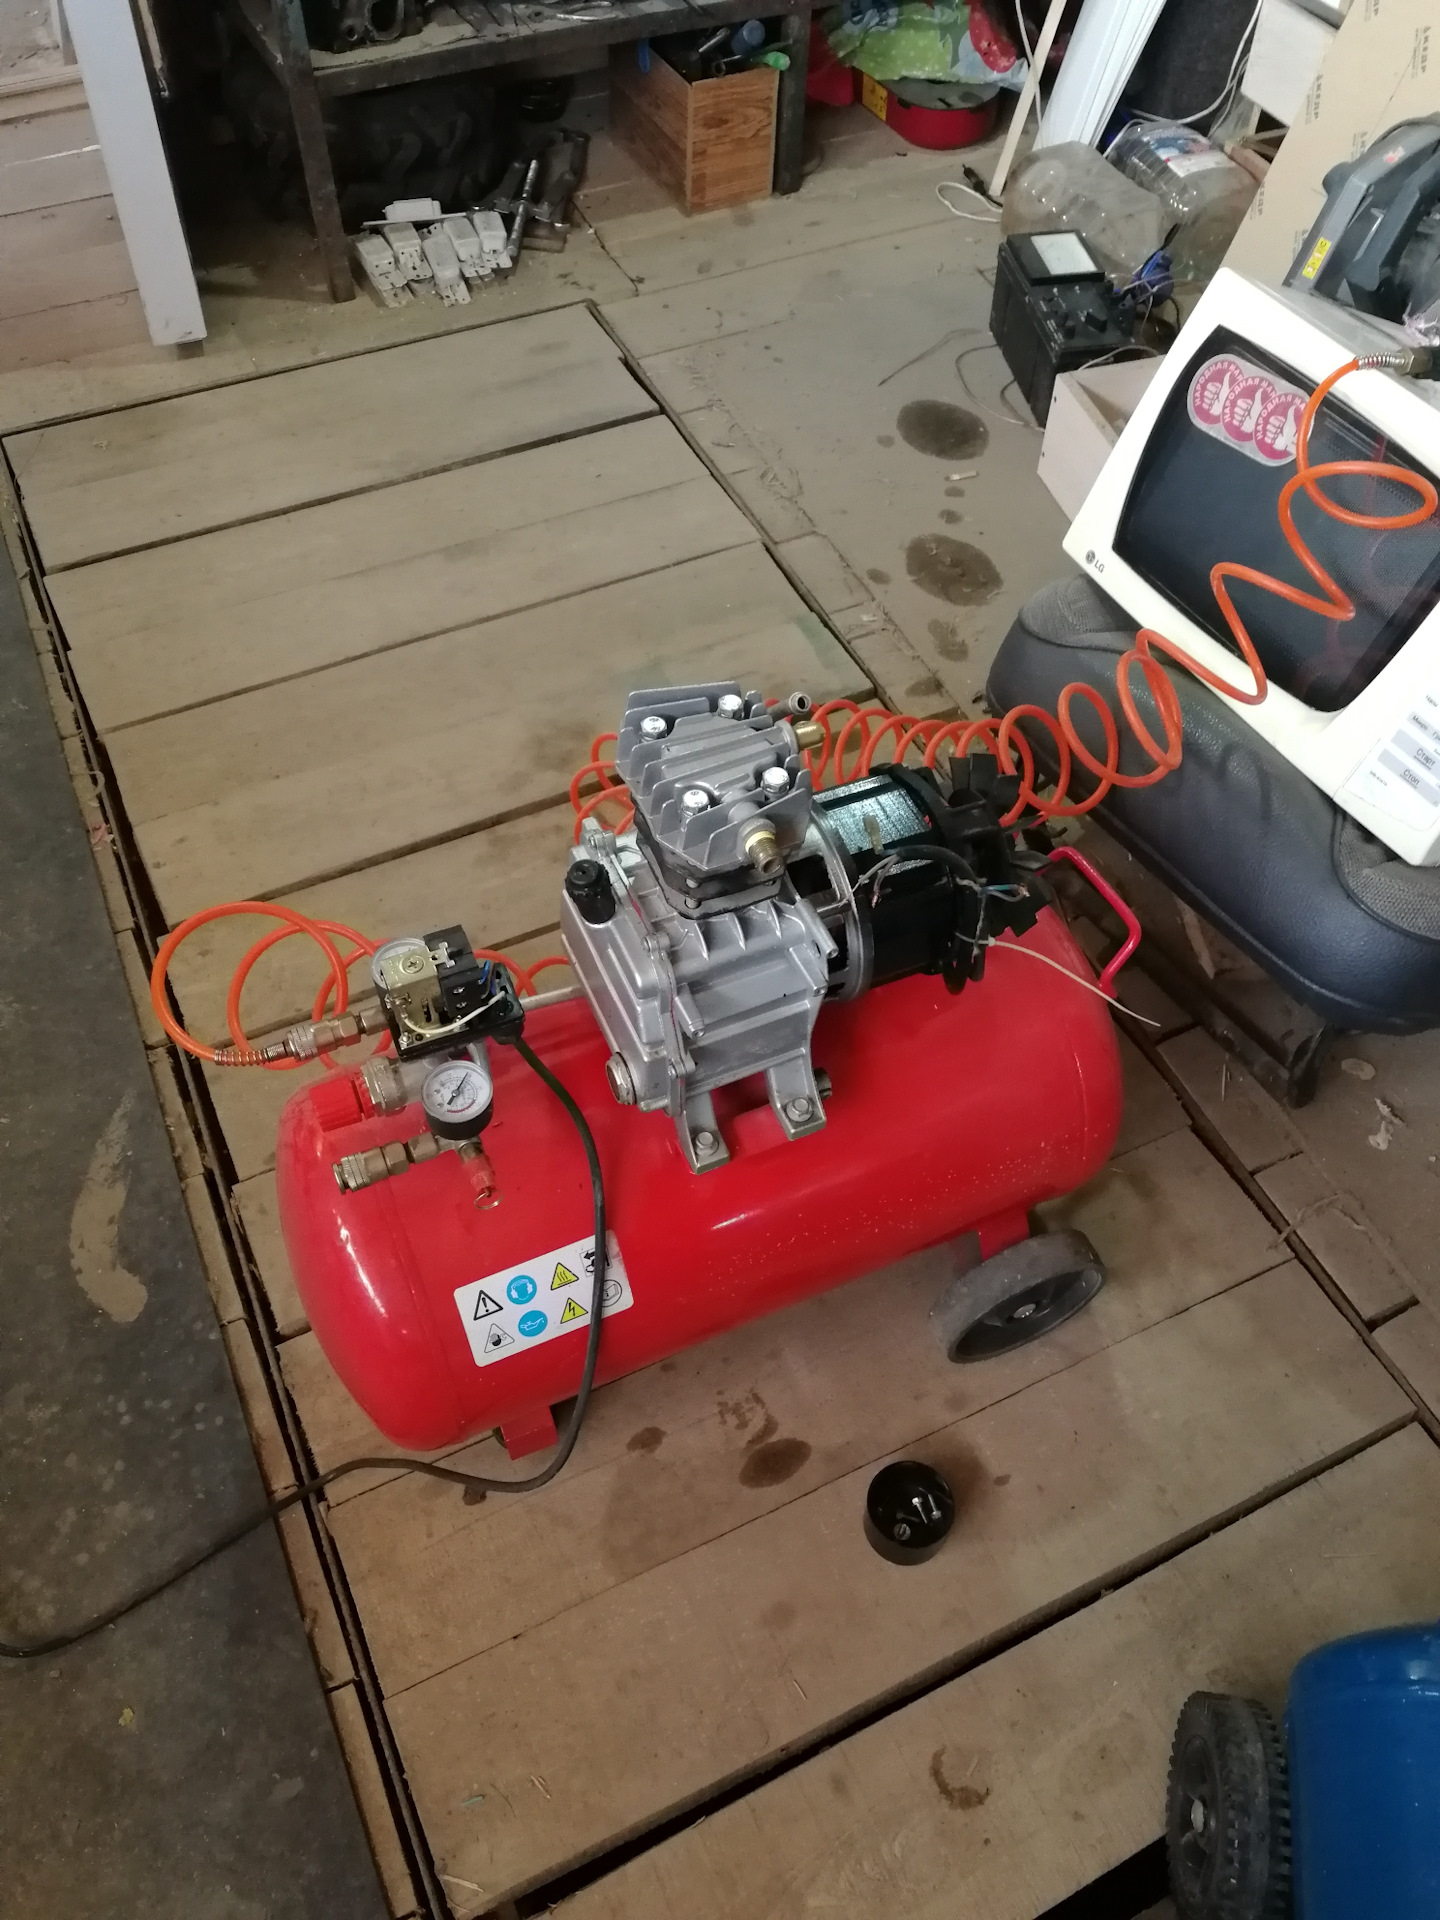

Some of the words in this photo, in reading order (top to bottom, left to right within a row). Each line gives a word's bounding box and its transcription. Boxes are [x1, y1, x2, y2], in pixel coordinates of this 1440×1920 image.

[1194, 361, 1229, 407] НАРОДНАЯ
[1223, 377, 1261, 424] НАРОДНАЯ
[1256, 394, 1293, 441] НАРОДНАЯ
[1094, 559, 1105, 574] LG
[1416, 748, 1436, 767] Старт
[1403, 768, 1420, 786] Стоп
